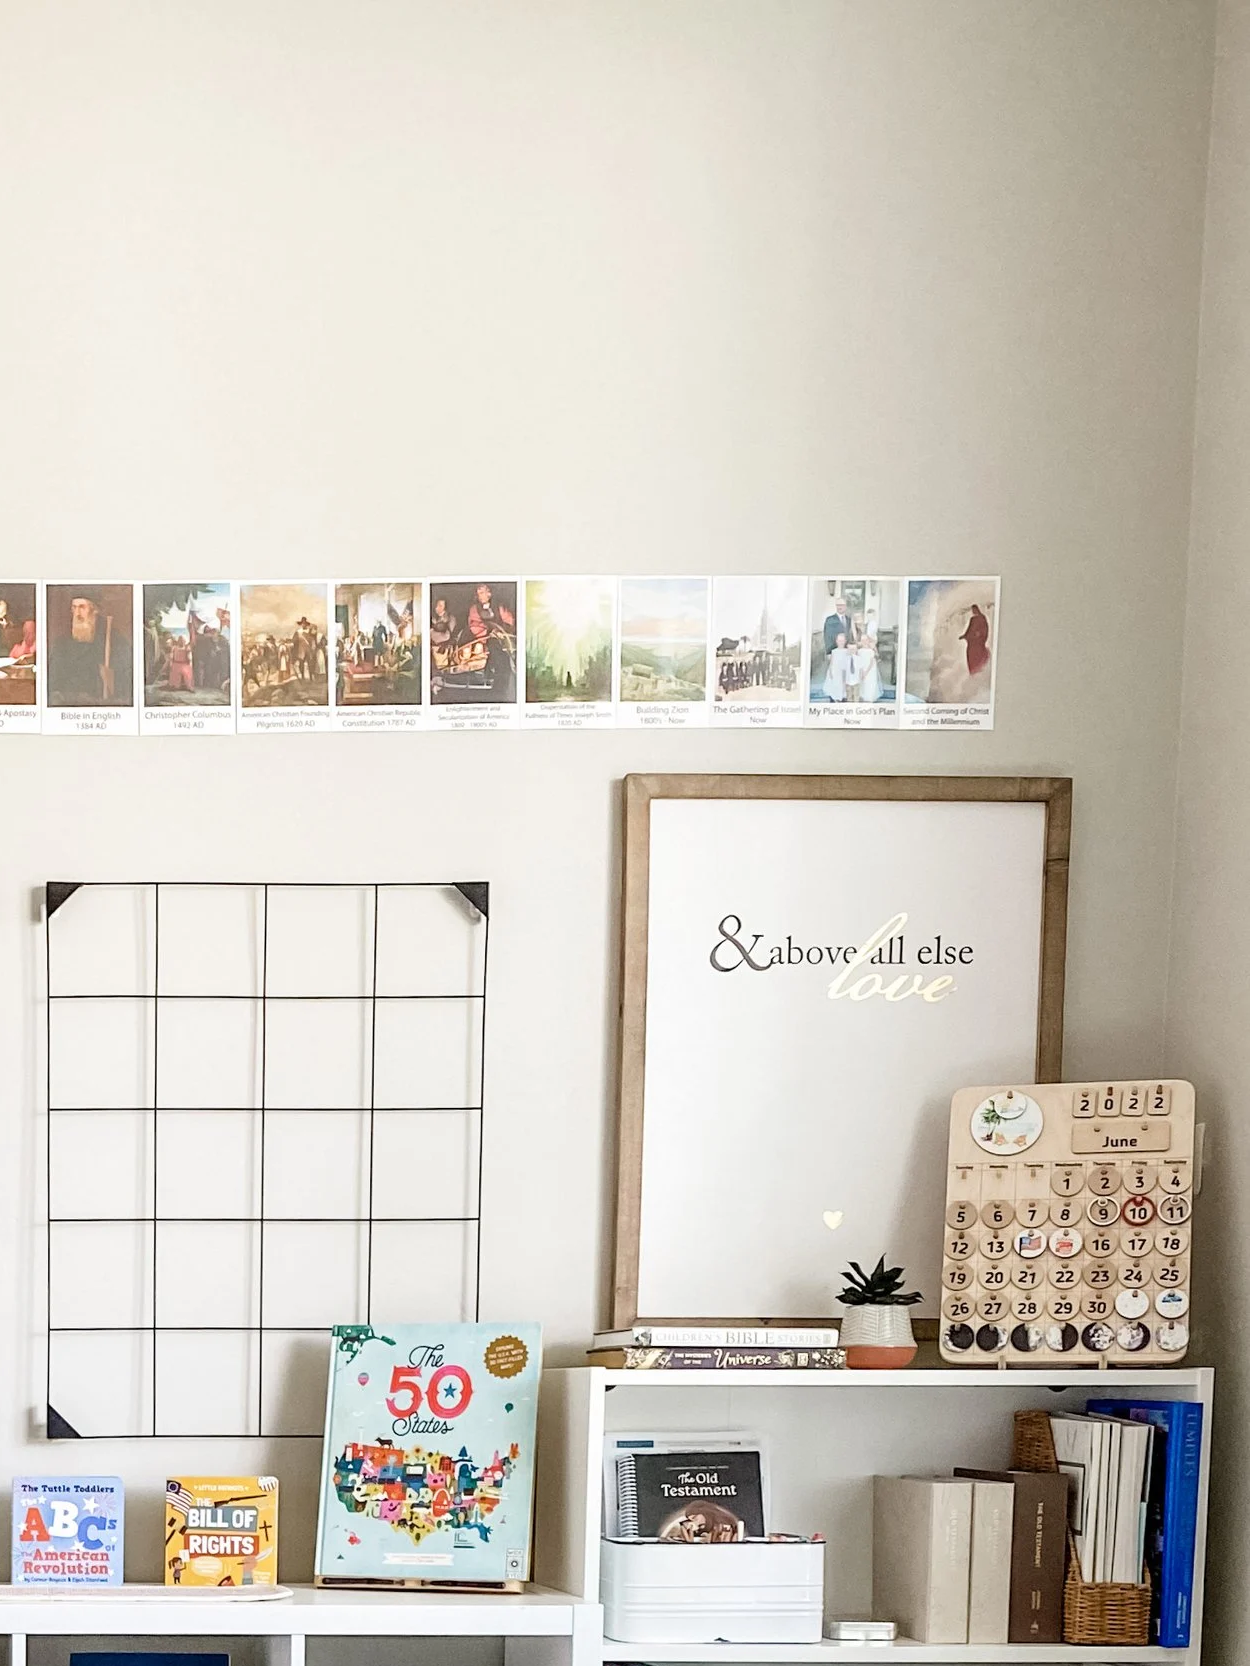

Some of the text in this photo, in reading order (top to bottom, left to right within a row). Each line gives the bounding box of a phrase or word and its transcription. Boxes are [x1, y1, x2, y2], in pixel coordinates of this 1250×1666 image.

[3, 710, 37, 719] Apostasy
[61, 712, 121, 721] Bible in English
[144, 711, 232, 720] Christopher Columbus
[808, 708, 896, 717] My Place in God's Plan
[174, 721, 204, 729] 1492 AD
[770, 936, 858, 966] above
[870, 936, 907, 965] all
[917, 936, 974, 966] else
[828, 912, 959, 1003] love
[1101, 1136, 1138, 1148] June
[1064, 1175, 1180, 1189] 1 2 3 4
[957, 1206, 1183, 1222] 5 6 7 8 9 10 11
[952, 1237, 1180, 1254] 12 13 16 17 18
[950, 1269, 1179, 1284] 19 20 21 22 23 24 25
[951, 1302, 1106, 1315] 26 27 28 29 30
[725, 1332, 775, 1345] BIBLE
[408, 1343, 445, 1368] The
[713, 1349, 772, 1368] Universe
[385, 1364, 474, 1419] 50
[392, 1412, 454, 1437] States
[677, 1471, 719, 1485] The Old
[21, 1484, 115, 1494] The Tuttle Toddlers
[660, 1484, 738, 1498] Testament
[196, 1497, 214, 1507] THE
[188, 1508, 257, 1530] BILL OF
[188, 1535, 255, 1556] RIGHTS
[1034, 1530, 1043, 1568] TESTAMENT
[32, 1548, 110, 1562] American
[22, 1561, 109, 1576] Revolution
